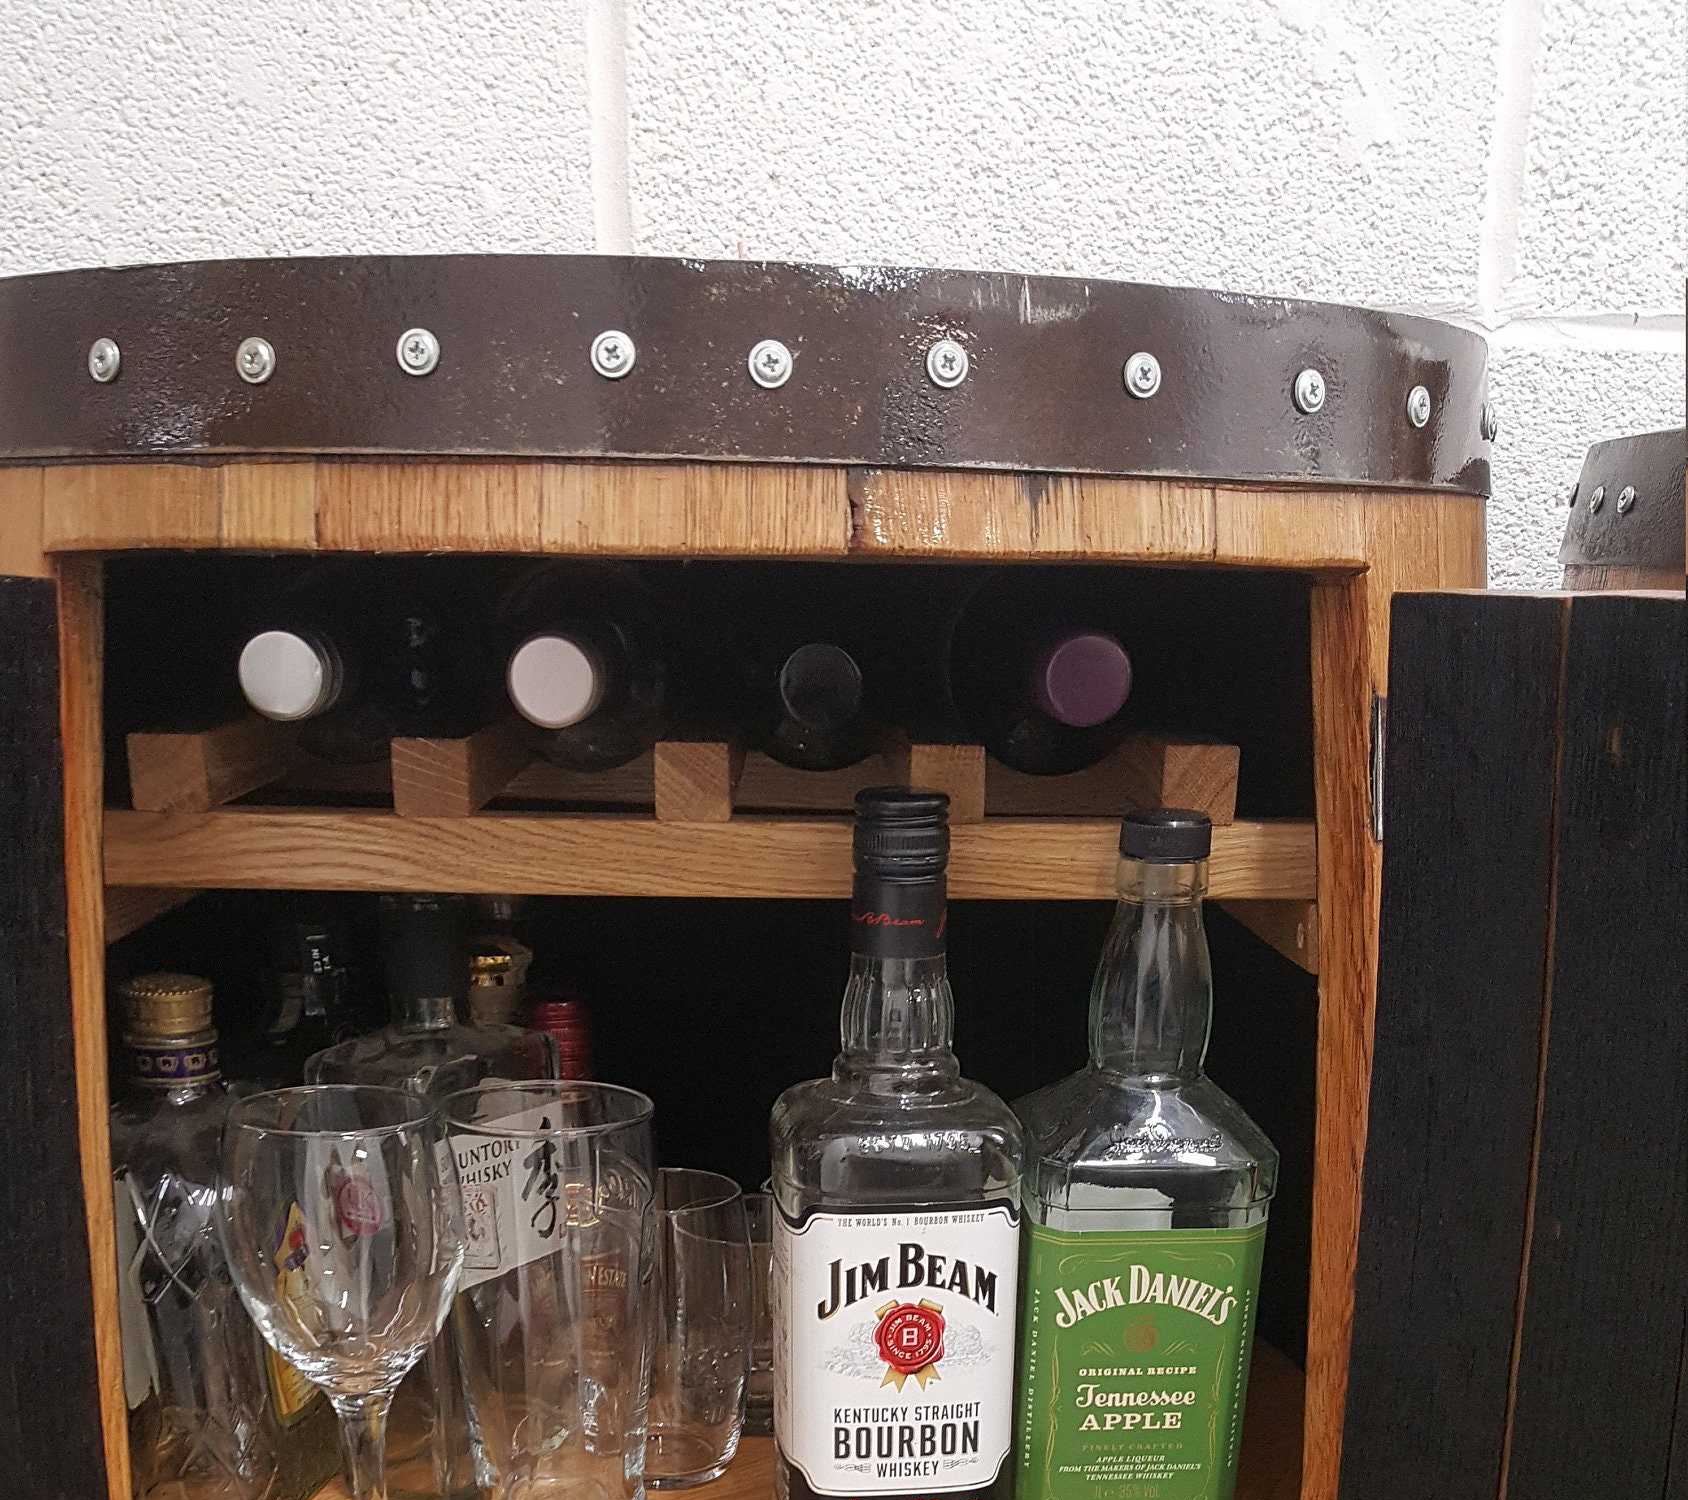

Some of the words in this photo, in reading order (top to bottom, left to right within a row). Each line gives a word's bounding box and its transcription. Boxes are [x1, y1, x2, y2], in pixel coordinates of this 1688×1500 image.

[458, 1139, 521, 1170] UNTORY
[838, 1218, 853, 1228] THE
[855, 1217, 888, 1228] WORLD'S
[891, 1217, 904, 1227] No.
[914, 1215, 950, 1226] BOURBON
[952, 1213, 985, 1224] WHISKEY
[817, 1257, 891, 1321] JIM
[896, 1242, 999, 1316] BEAM
[1031, 1288, 1041, 1324] JACK
[1054, 1276, 1127, 1329] JACK
[1128, 1264, 1238, 1326] DANIEL'S
[889, 1317, 903, 1333] JIM
[905, 1314, 932, 1332] BEAM
[902, 1327, 918, 1347] B
[887, 1339, 912, 1360] SINCE
[1027, 1330, 1038, 1381] DANIEL
[1078, 1366, 1144, 1378] ORIGINAL
[1146, 1365, 1197, 1376] RECIPE
[1075, 1383, 1197, 1409] Tennessee
[833, 1406, 909, 1424] KENTUCKY
[914, 1401, 982, 1422] STRAIGHT
[1078, 1411, 1183, 1432] APPLE
[1023, 1387, 1034, 1468] DISTILLERY
[833, 1419, 980, 1460] BOURBON
[1081, 1442, 1125, 1452] FINELY
[1128, 1442, 1184, 1451] CRAFTED
[875, 1460, 940, 1479] WHISKEY
[1058, 1465, 1082, 1473] FROM
[1083, 1465, 1100, 1473] THE
[1100, 1464, 1135, 1473] MAKERS
[1134, 1464, 1146, 1472] OF
[1144, 1464, 1166, 1473] JACK
[1165, 1463, 1202, 1471] DANIEL'S
[1095, 1456, 1124, 1464] APPLE
[1125, 1454, 1166, 1463] LIQUEUR
[1085, 1472, 1134, 1481] TENNESSEE
[1135, 1472, 1175, 1480] WHISKEY
